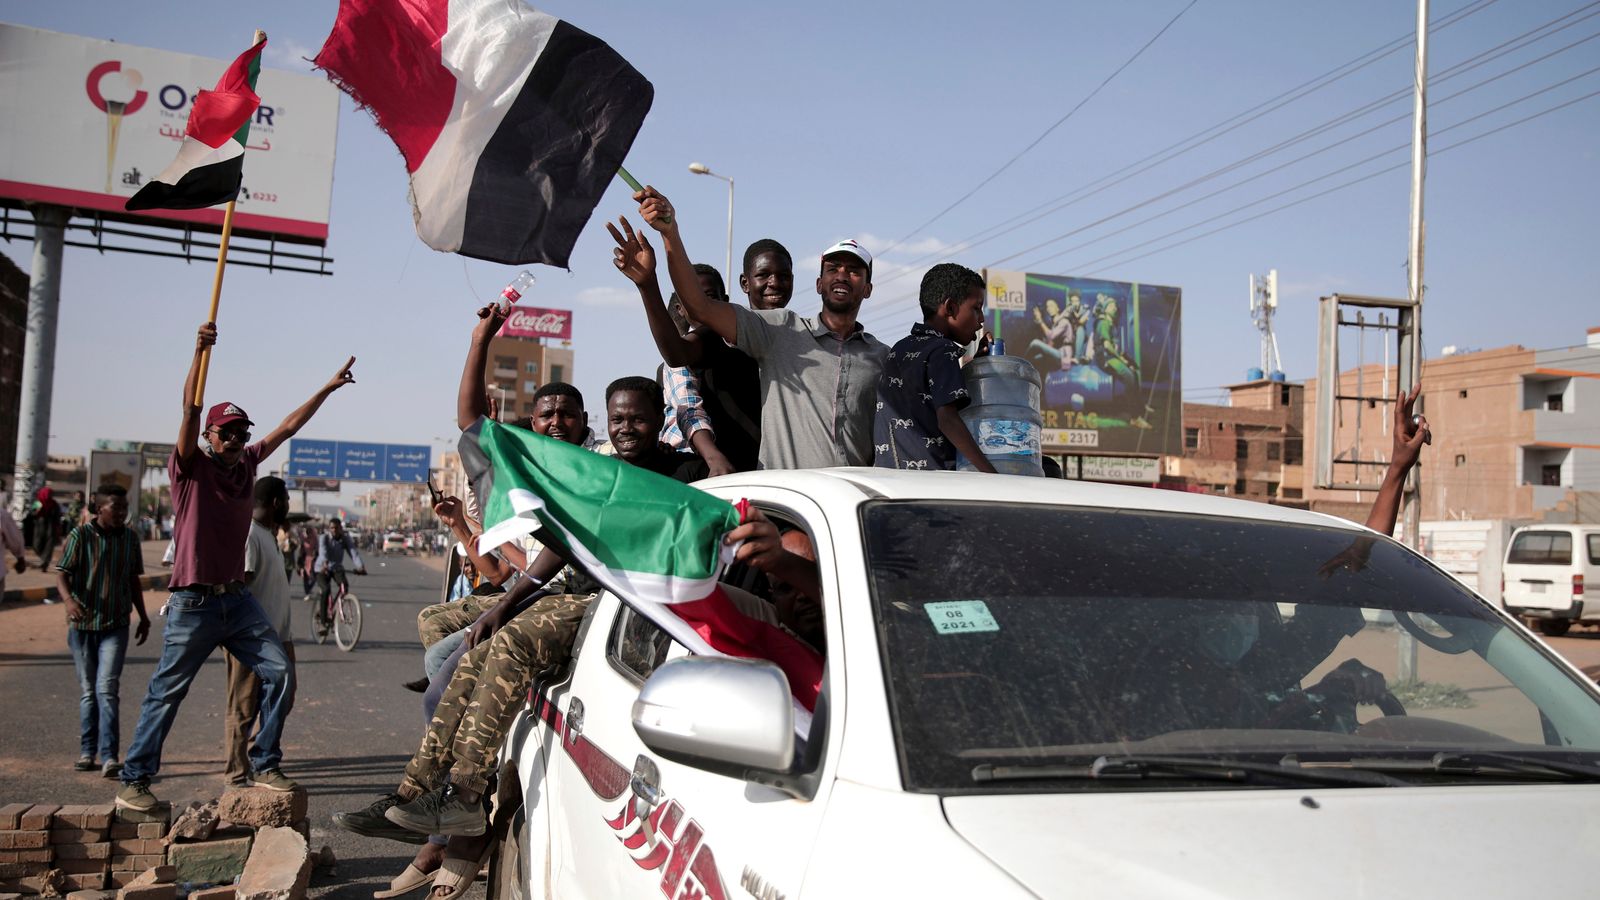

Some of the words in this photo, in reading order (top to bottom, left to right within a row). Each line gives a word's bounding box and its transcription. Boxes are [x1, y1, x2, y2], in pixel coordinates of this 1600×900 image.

[122, 167, 141, 186] alt
[992, 287, 1023, 304] Tara
[509, 310, 566, 333] Coca-Cola
[1064, 411, 1098, 429] TAG
[1070, 432, 1097, 444] 2317
[1126, 470, 1143, 479] LTD
[945, 610, 964, 619] 08
[941, 621, 976, 630] 2021
